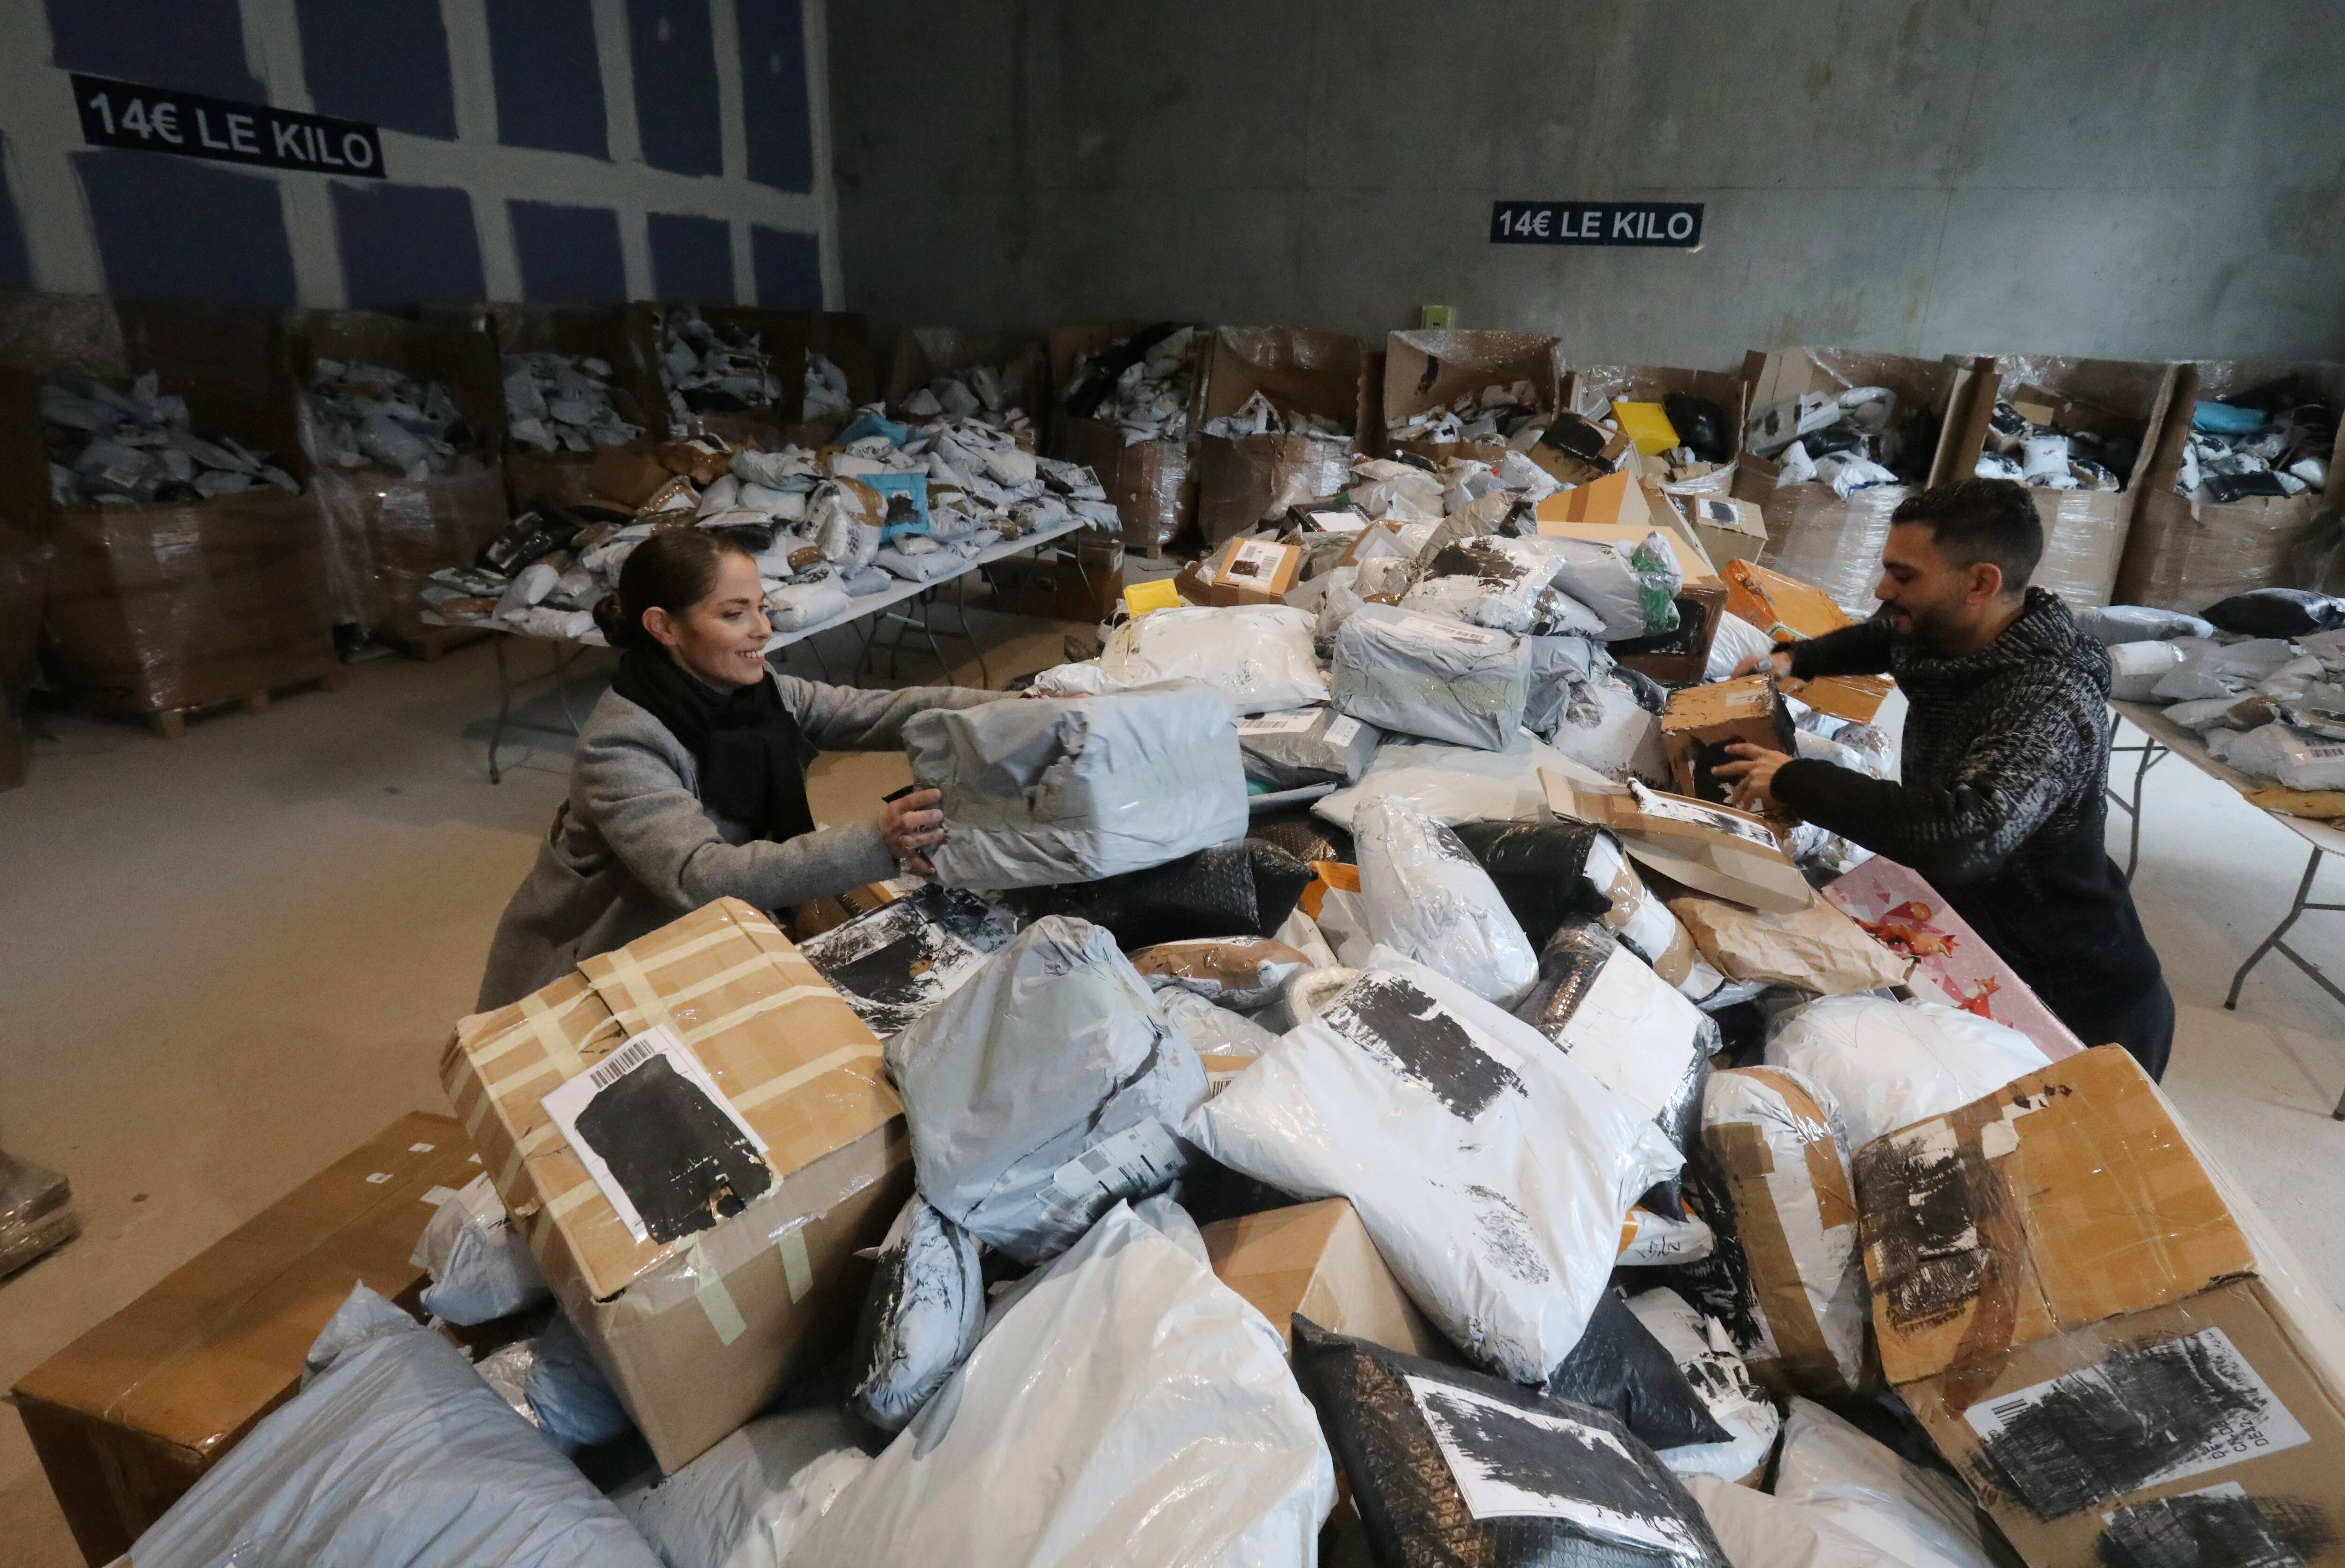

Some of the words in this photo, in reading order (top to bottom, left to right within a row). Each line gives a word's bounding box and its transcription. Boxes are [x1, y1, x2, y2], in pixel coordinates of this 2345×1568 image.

[90, 92, 183, 143] 14€
[195, 108, 260, 153] LE
[269, 120, 374, 169] KILO
[1499, 210, 1552, 237] 14€
[1560, 211, 1602, 238] LE
[1612, 212, 1694, 239] KILO
